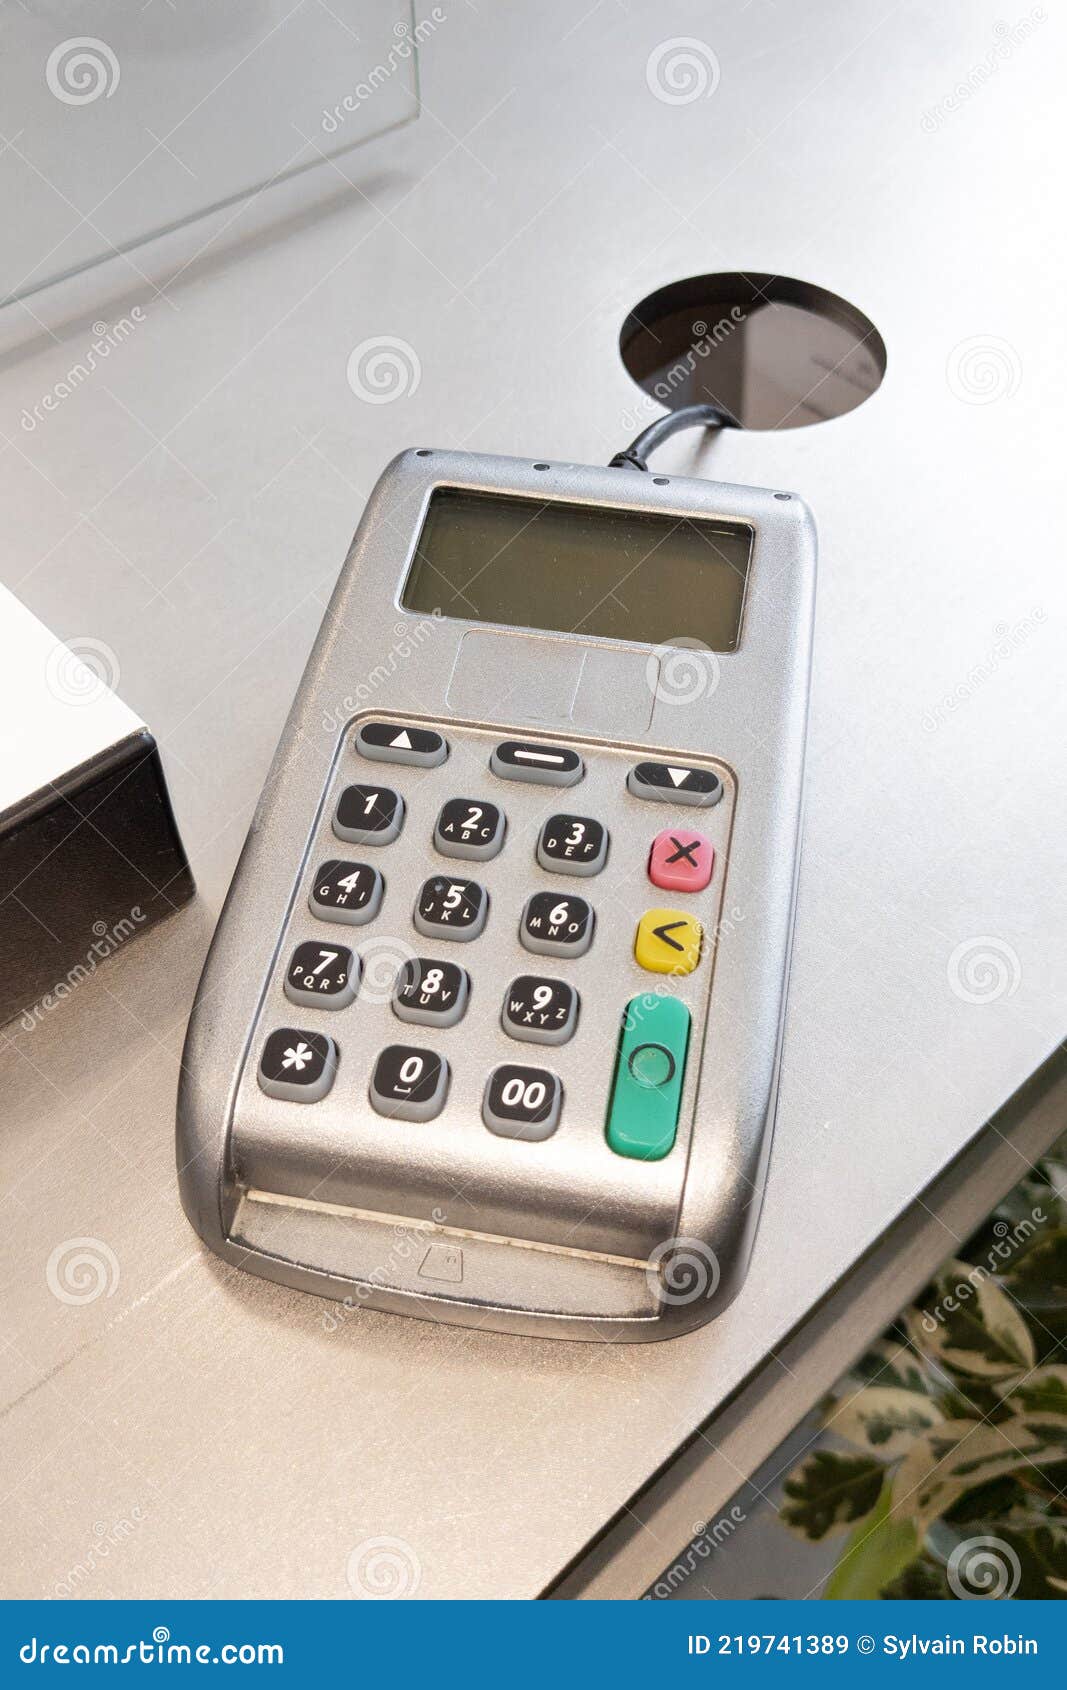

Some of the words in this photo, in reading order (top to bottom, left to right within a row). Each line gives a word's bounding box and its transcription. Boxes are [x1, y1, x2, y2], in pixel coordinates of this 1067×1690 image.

[363, 793, 379, 815] 1
[461, 807, 483, 830] 2
[564, 823, 586, 845] 3
[338, 871, 361, 893] 4
[443, 885, 465, 908] 5
[549, 901, 569, 925] 6
[312, 950, 339, 975] 7
[421, 968, 444, 994] 8
[532, 985, 553, 1010] 9
[399, 1056, 424, 1083] 0
[501, 1078, 546, 1110] 00
